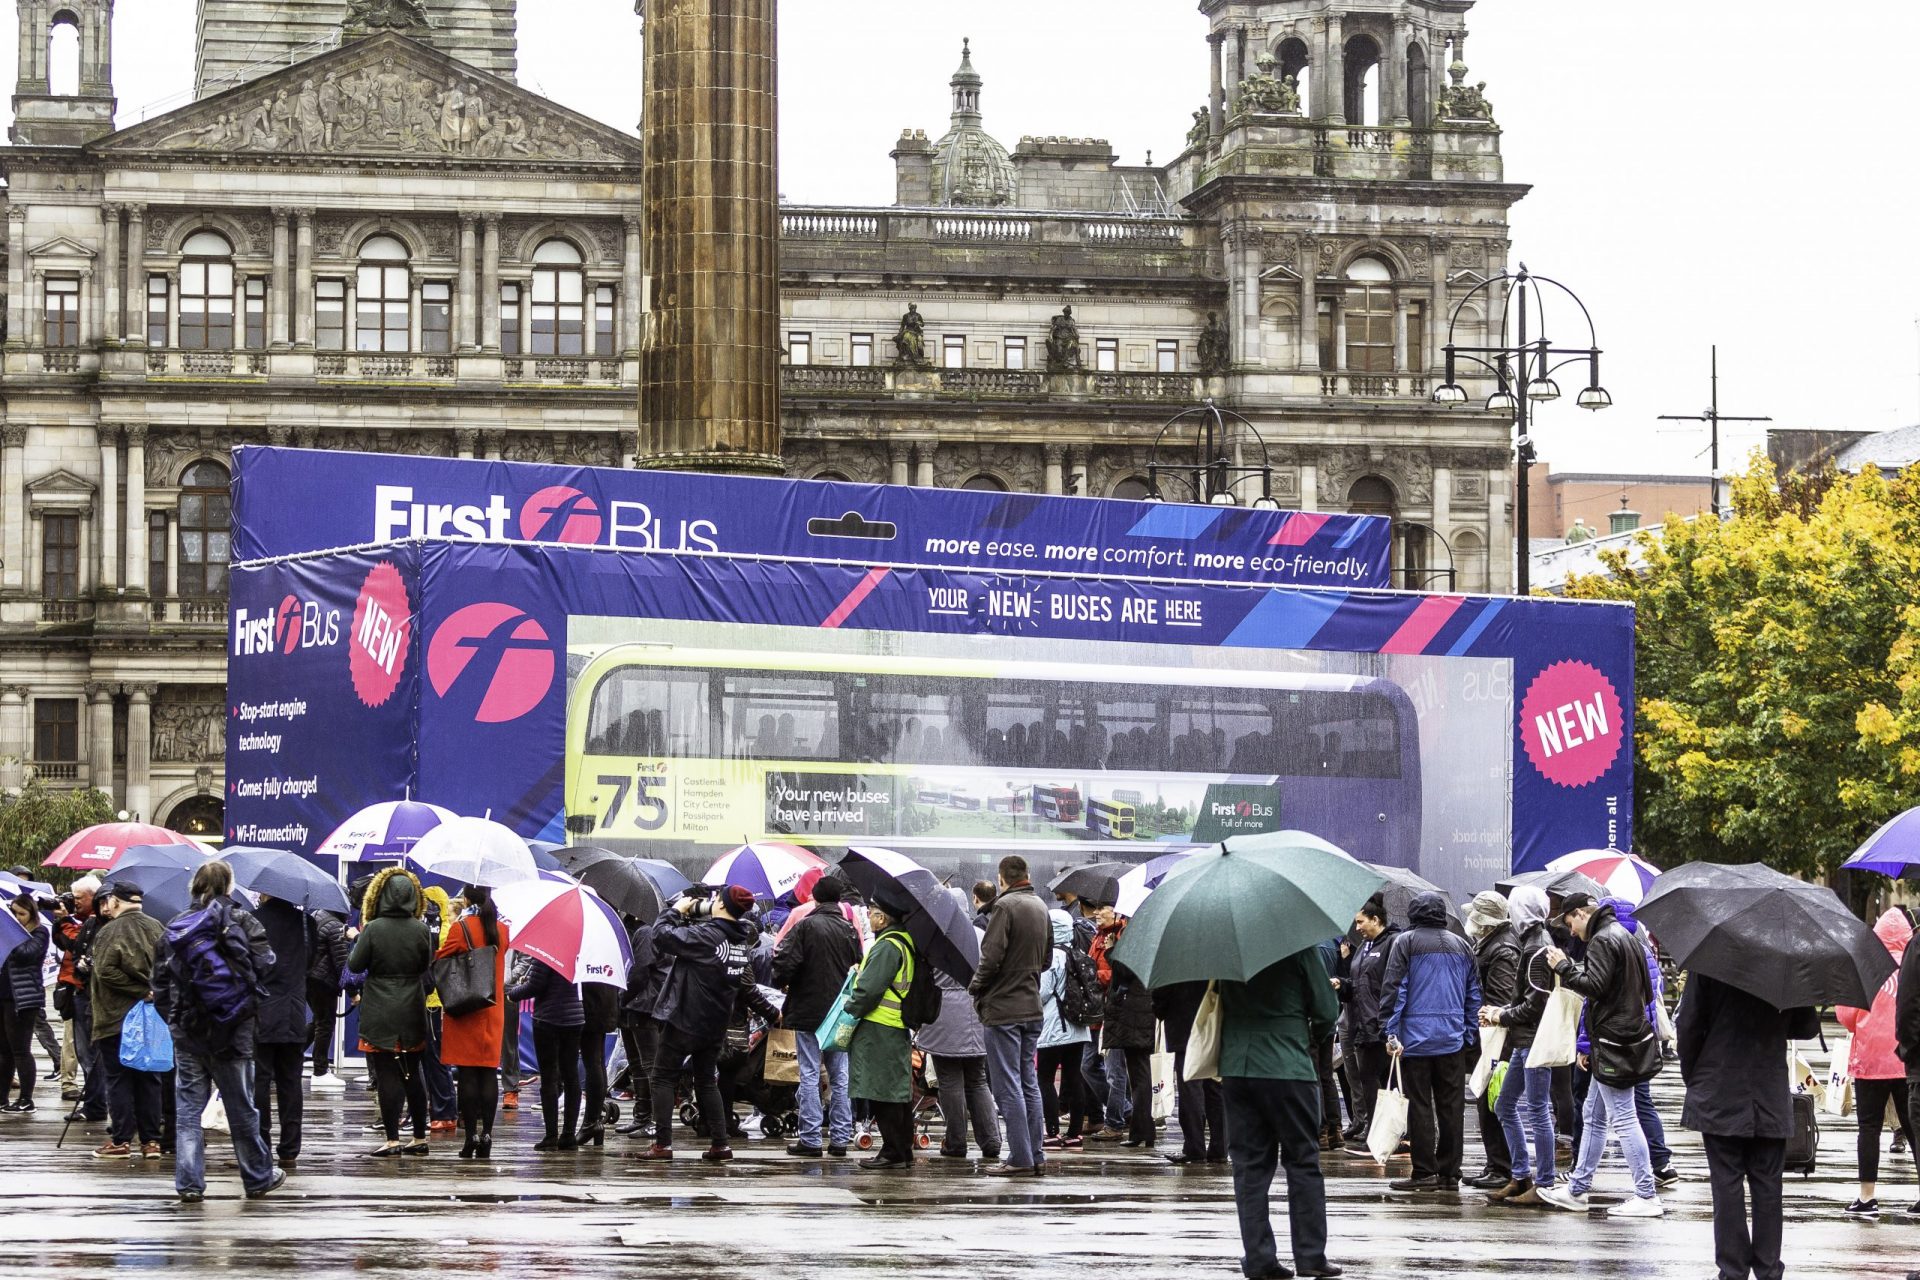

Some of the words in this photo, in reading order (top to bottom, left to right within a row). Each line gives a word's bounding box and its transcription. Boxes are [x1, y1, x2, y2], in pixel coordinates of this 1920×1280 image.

[374, 485, 511, 541] First
[609, 500, 719, 552] Bus
[925, 538, 981, 555] more
[986, 541, 1038, 558] ease.
[1044, 544, 1098, 561] more
[1103, 546, 1187, 568] comfort.
[1193, 552, 1245, 570] more
[1250, 554, 1369, 580] eco-friendly.
[928, 587, 968, 609] YOUR
[989, 590, 1031, 618] NEW
[1050, 593, 1113, 622] BUSES
[1121, 597, 1158, 625] ARE
[1165, 600, 1202, 621] HERE
[234, 607, 275, 656] First
[302, 601, 340, 649] Bus
[357, 596, 403, 676] NEW
[239, 700, 278, 724] Stop-start
[279, 697, 307, 721] engine
[1534, 691, 1609, 758] NEW
[239, 730, 282, 753] technology
[637, 762, 655, 773] First
[237, 778, 262, 797] Comes
[262, 777, 282, 800] fully
[282, 775, 317, 799] charged
[683, 789, 724, 799] Hampden
[775, 786, 811, 802] Your
[814, 790, 844, 802] new
[847, 787, 889, 803] buses
[597, 775, 669, 831] 75
[683, 800, 701, 811] City
[702, 800, 731, 810] Centre
[775, 805, 810, 822] have
[813, 807, 864, 822] arrived
[1211, 802, 1236, 816] First
[1252, 803, 1273, 816] Bus
[1606, 796, 1617, 815] all
[682, 823, 709, 832] Milton
[1221, 819, 1232, 827] Full
[1234, 819, 1242, 827] of
[236, 824, 257, 842] Wi-Fi
[257, 822, 308, 846] connectivity
[586, 964, 602, 974] First
[772, 1050, 789, 1059] First
